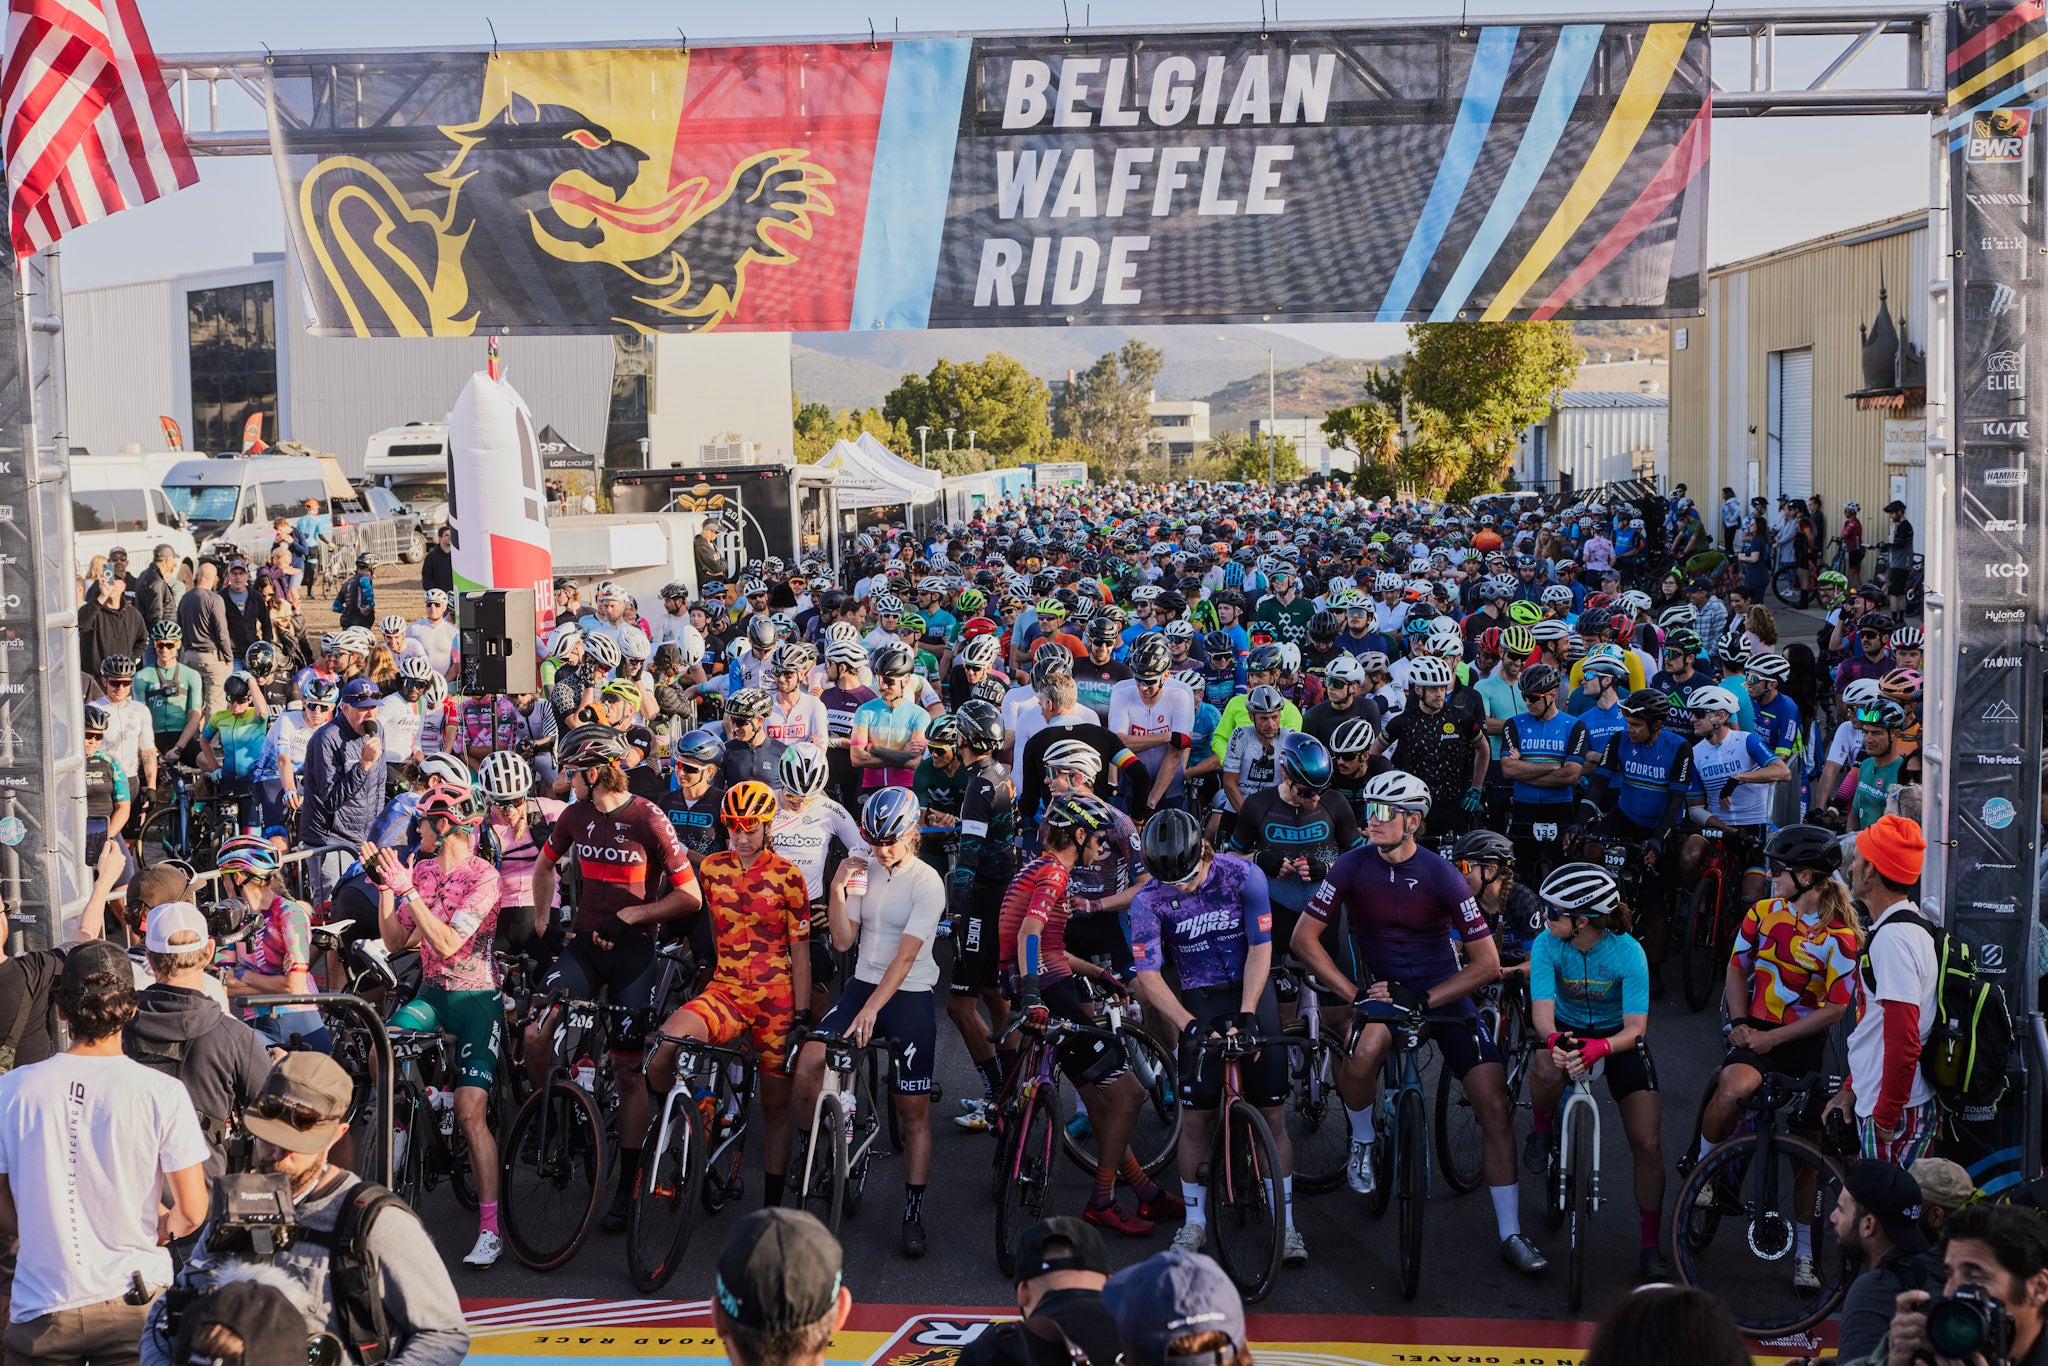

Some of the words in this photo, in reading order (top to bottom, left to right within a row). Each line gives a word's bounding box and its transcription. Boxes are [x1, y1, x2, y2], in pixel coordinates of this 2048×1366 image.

[1002, 54, 1336, 129] BELGIAN
[1970, 138, 2022, 158] BWR
[997, 145, 1295, 219] WAFFLE
[1967, 193, 2031, 205] CANYON
[973, 236, 1150, 307] RIDE
[1987, 375, 2022, 391] ELIEL
[1983, 421, 2029, 435] KASK
[540, 442, 567, 452] OST
[1987, 472, 2026, 480] HAMMER
[1985, 609, 2025, 622] Hyland's
[768, 726, 781, 738] 3T
[1589, 727, 1605, 735] SAN
[1231, 727, 1243, 753] KENDA
[1520, 738, 1565, 751] COUREUR
[1977, 755, 1996, 764] The
[1996, 755, 2021, 764] Feed.
[1624, 760, 1666, 780] COUREUR
[1702, 760, 1743, 778] COUREUR
[5, 777, 29, 786] Feed.
[220, 804, 238, 815] 223
[821, 802, 846, 820] Jukebox
[671, 813, 708, 825] ABUS
[646, 801, 681, 856] TOYOTA
[1272, 825, 1323, 841] ABUS
[1536, 829, 1555, 838] 135
[1702, 829, 1723, 838] 1048
[771, 833, 822, 848] ukebox
[576, 843, 644, 862] TOYOTA
[1605, 854, 1625, 865] 1399
[1574, 894, 1593, 906] LAZER
[1174, 909, 1231, 934] mike's
[1188, 918, 1240, 940] bikes
[1407, 1035, 1418, 1048] 3
[393, 1044, 423, 1058] 214
[834, 1055, 852, 1068] 12
[68, 1110, 79, 1165] CYCLING
[1814, 1190, 1822, 1218] Canon
[64, 1171, 82, 1266] PERFORMANCE
[534, 1336, 616, 1345] RACE
[634, 1337, 716, 1346] ROAD
[1391, 1354, 1500, 1364] GRAVEL
[1513, 1357, 1545, 1366] OF
